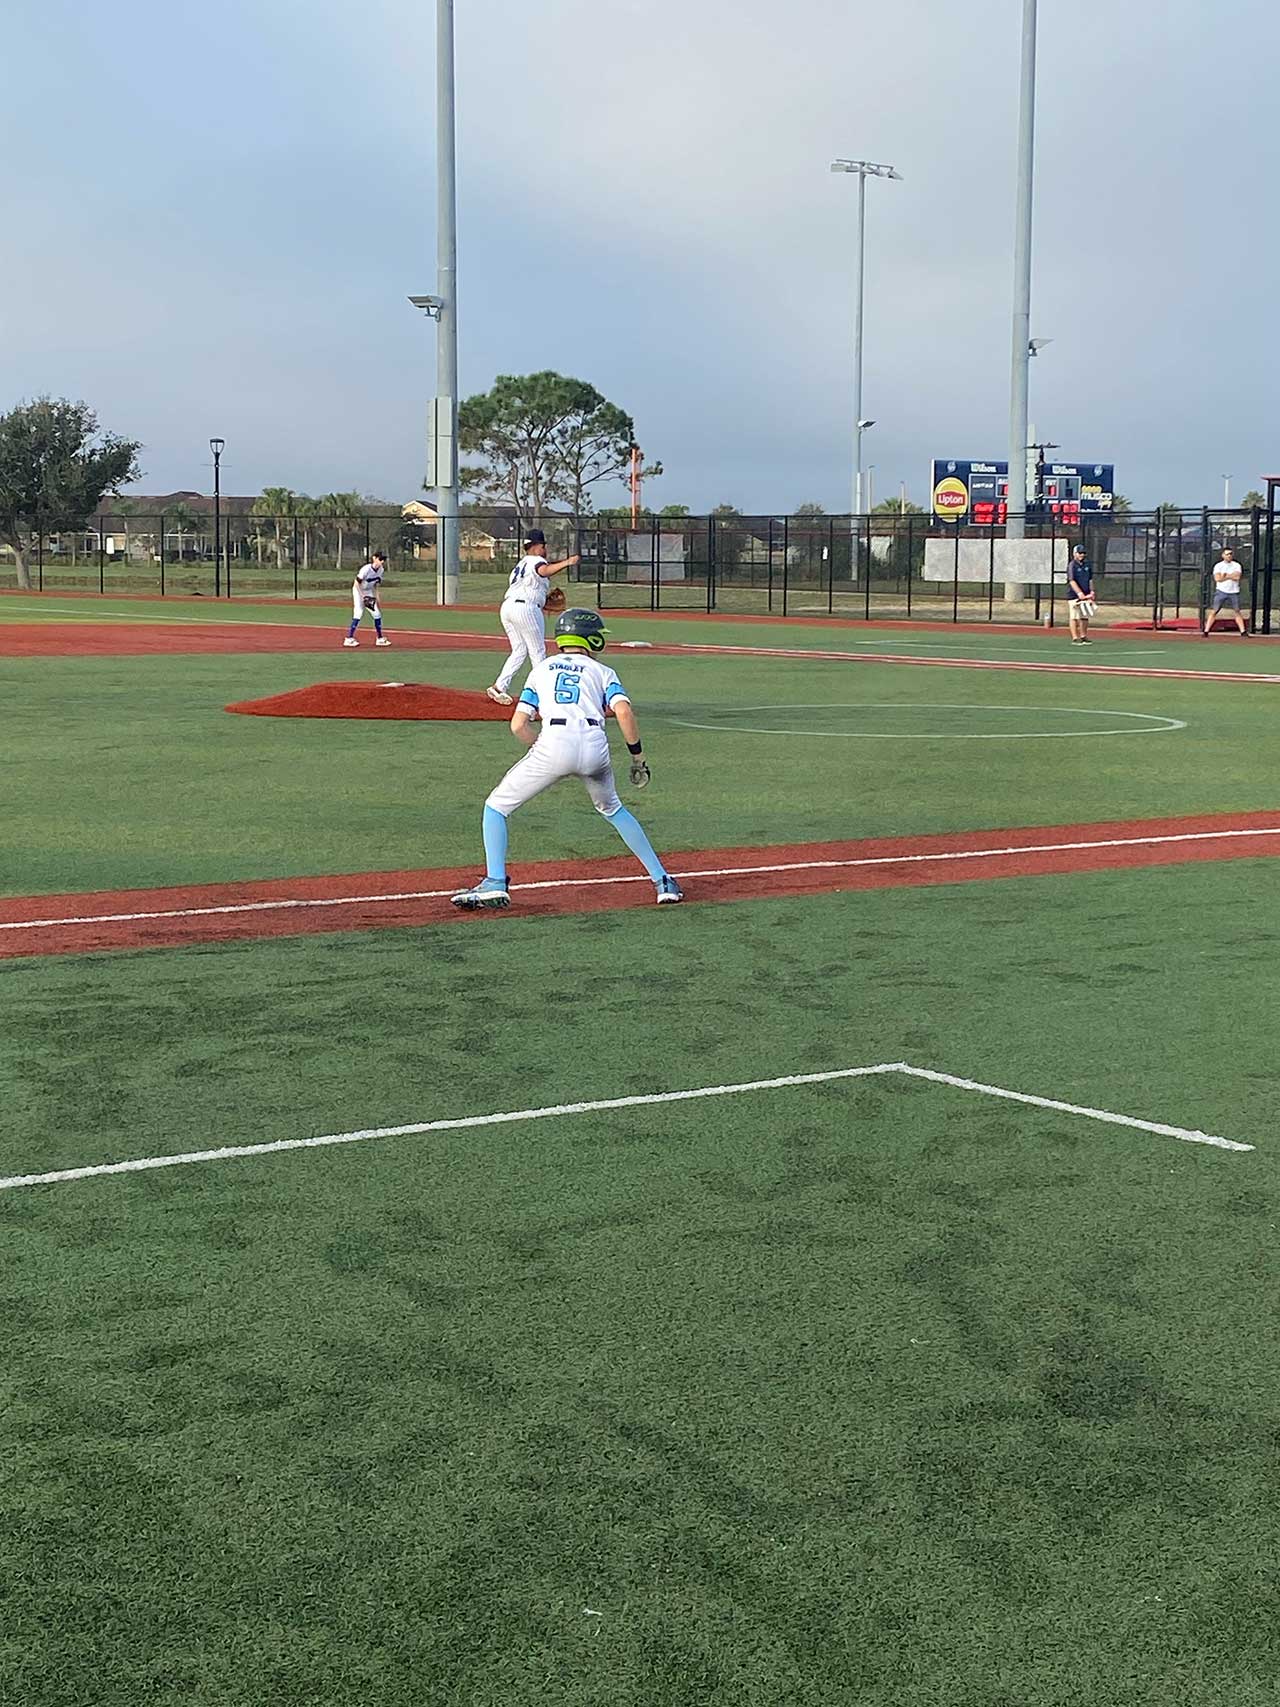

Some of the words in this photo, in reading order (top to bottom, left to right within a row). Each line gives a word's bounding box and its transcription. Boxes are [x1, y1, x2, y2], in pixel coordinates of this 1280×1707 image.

[970, 463, 997, 473] Wilson
[938, 494, 964, 506] Lipton
[554, 671, 581, 705] 5
